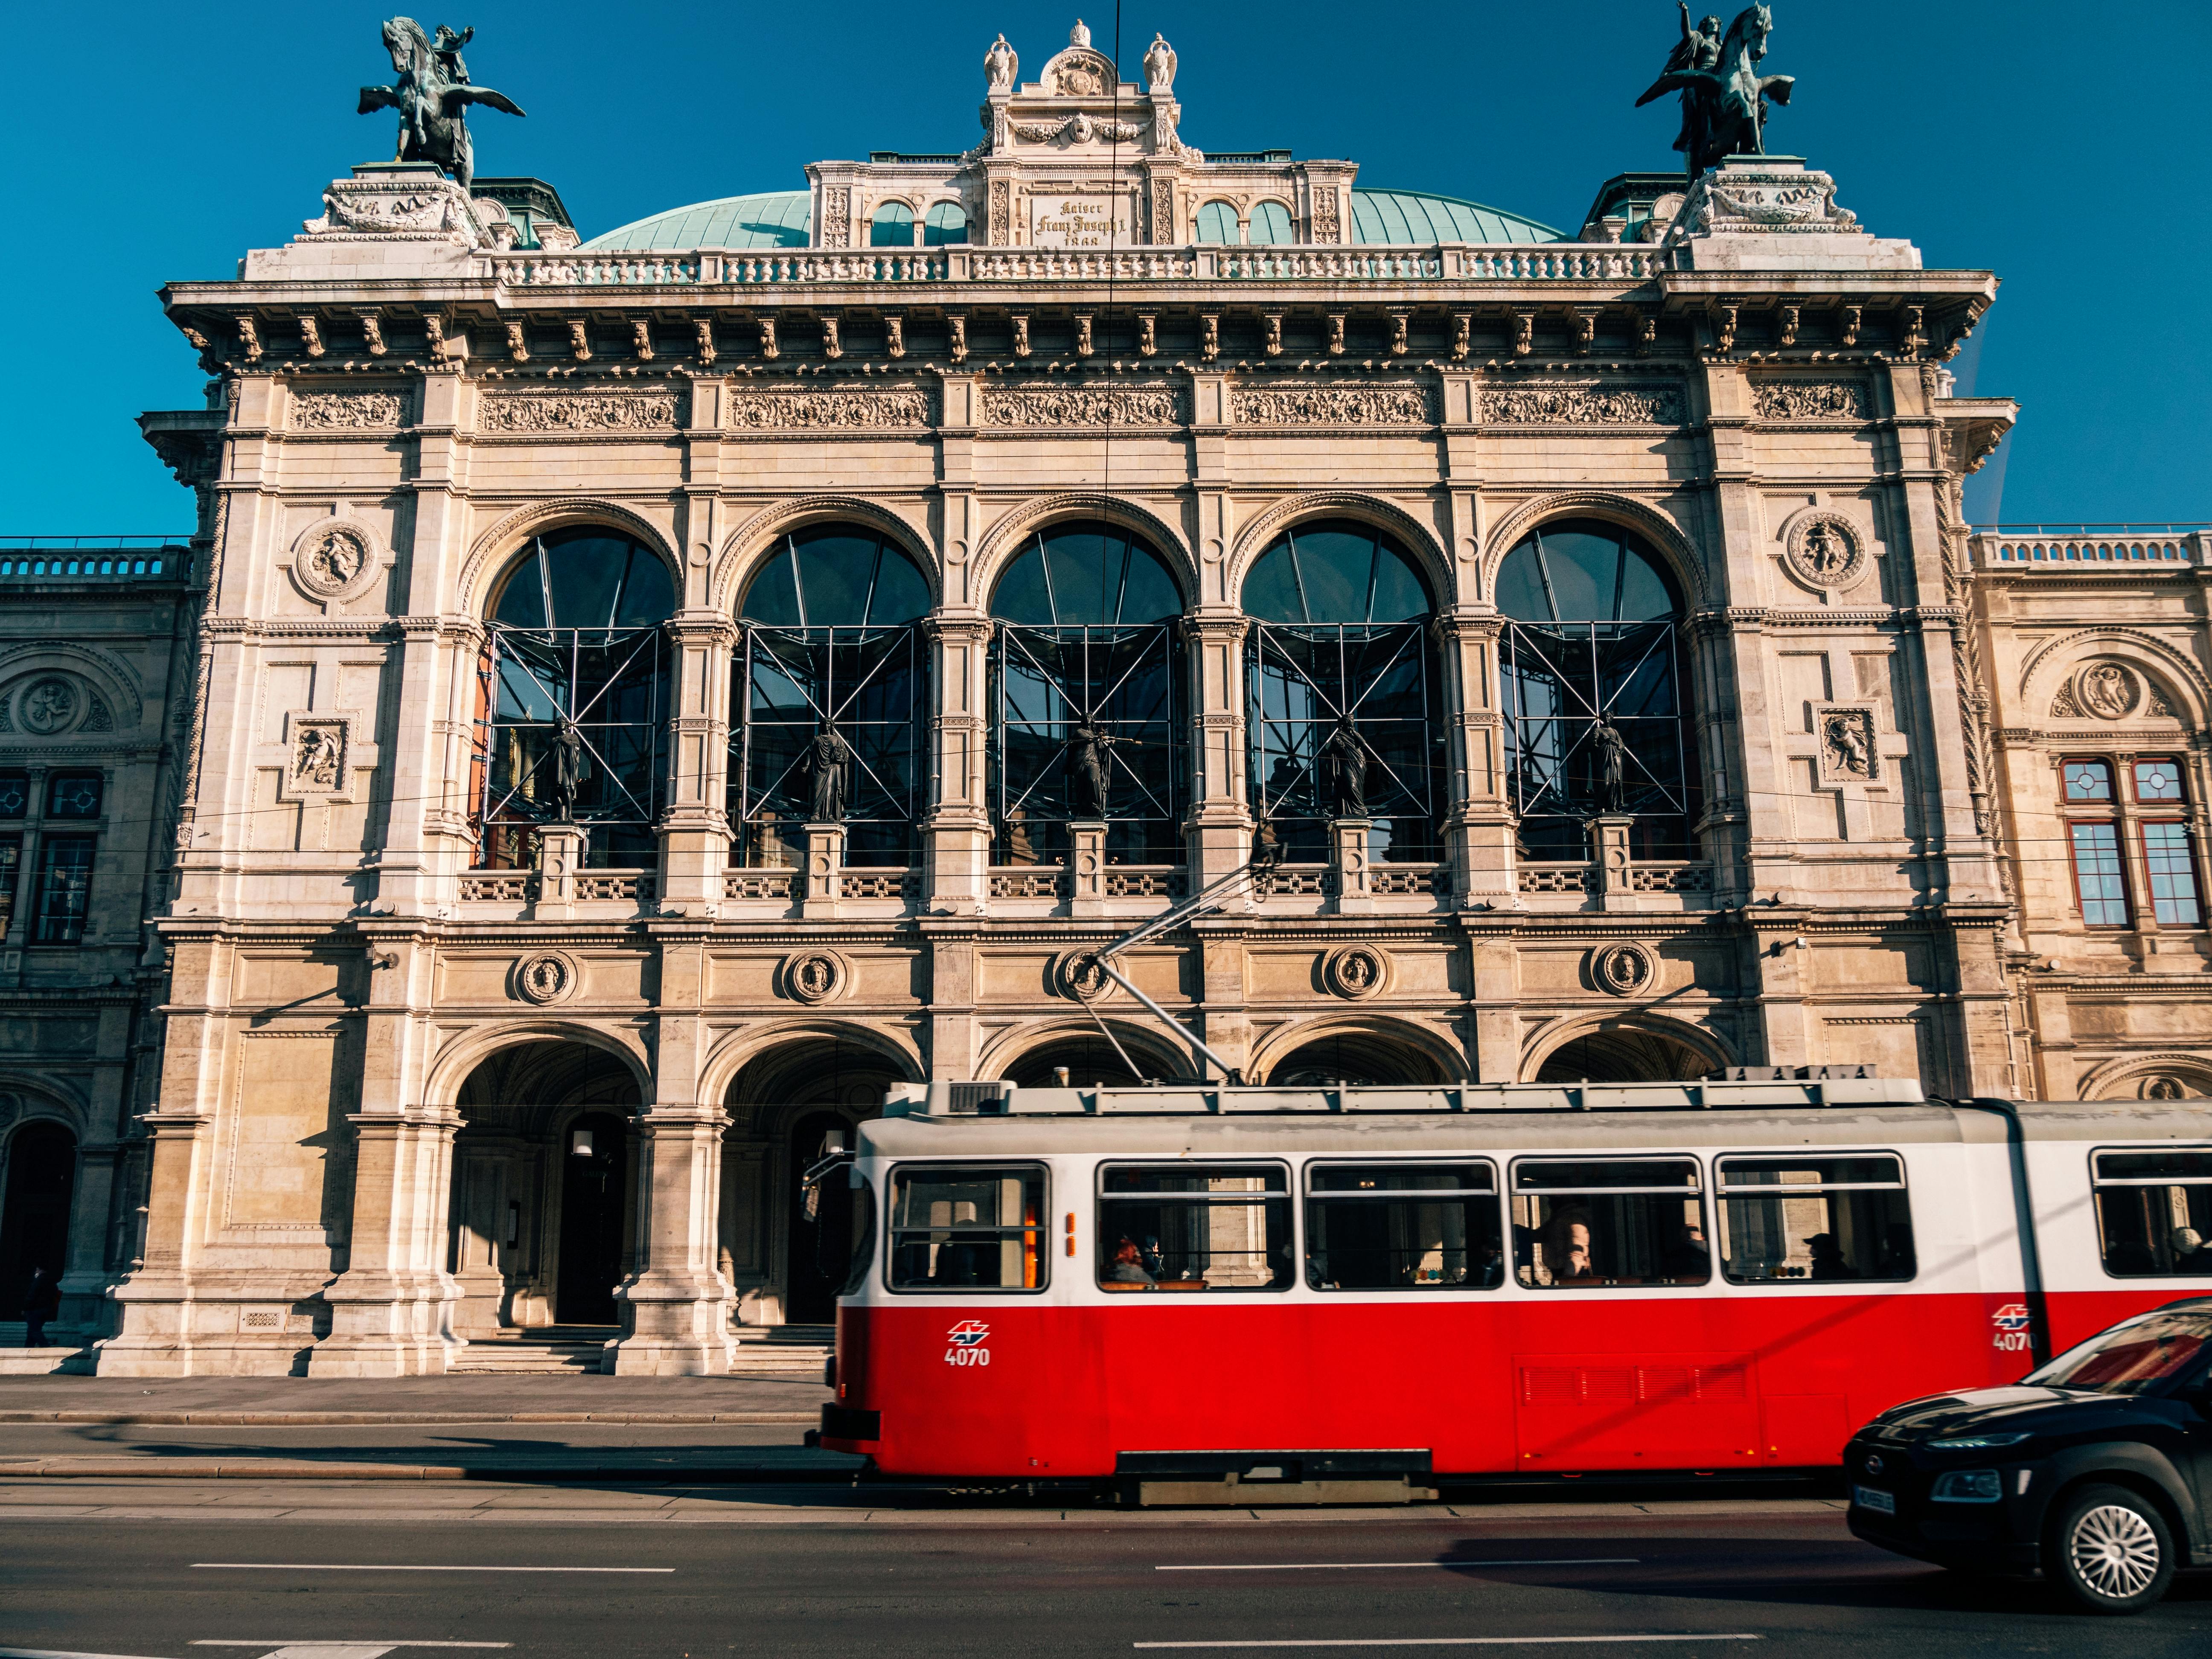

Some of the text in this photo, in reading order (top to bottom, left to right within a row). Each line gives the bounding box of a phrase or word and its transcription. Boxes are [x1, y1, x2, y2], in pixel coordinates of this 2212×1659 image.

[1060, 201, 1103, 215] Kaiser
[1035, 215, 1070, 236] Franz
[1073, 215, 1117, 236] Joseph
[1063, 237, 1099, 246] 1868
[1992, 1332, 2038, 1351] 4070
[944, 1348, 990, 1366] 4070
